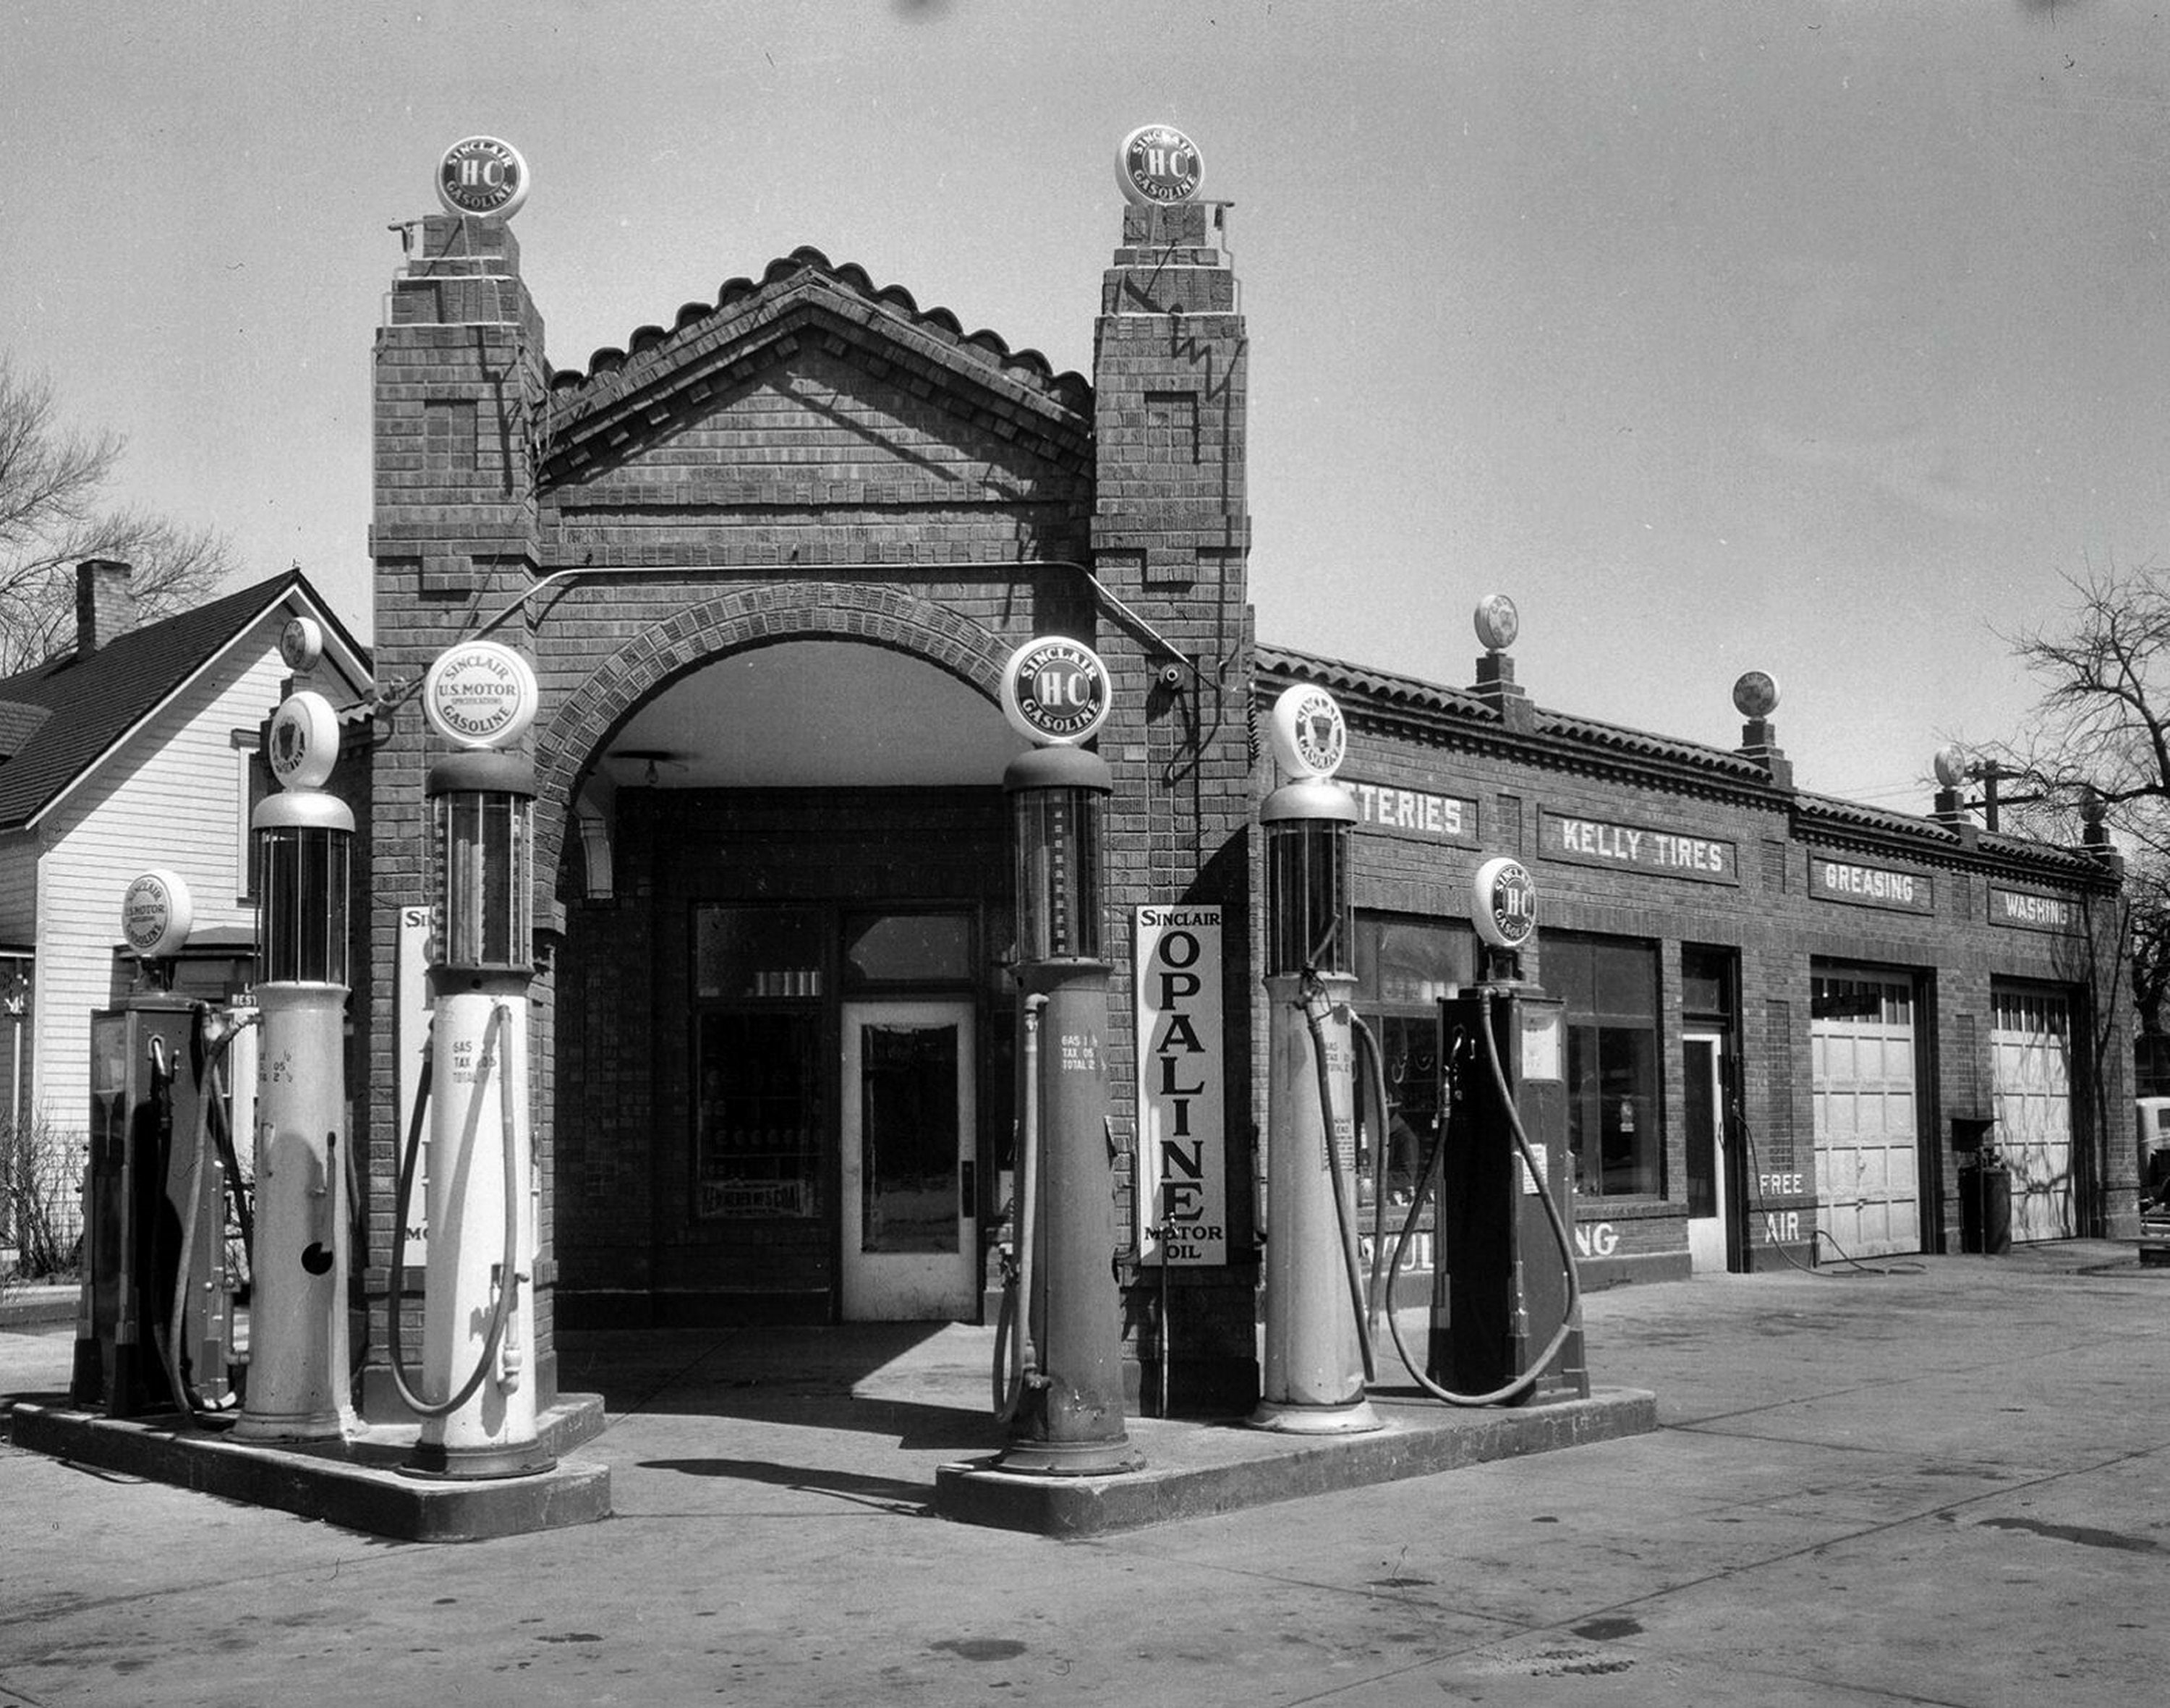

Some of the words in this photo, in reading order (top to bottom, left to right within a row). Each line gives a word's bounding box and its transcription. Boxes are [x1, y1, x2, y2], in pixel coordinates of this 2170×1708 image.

[447, 142, 513, 168] SINCLAIR
[446, 180, 514, 208] GASOLINE
[1133, 169, 1196, 200] GASOLINE
[444, 655, 509, 680] SINCLAIR
[1021, 647, 1097, 681] SINCLAIR
[443, 705, 511, 732] GASOLINE
[1022, 698, 1100, 732] GASOLINE
[1562, 819, 1641, 861] KELLY
[1654, 834, 1722, 872] TIRES
[1494, 867, 1534, 894] SINCL
[1825, 863, 1914, 903] GREASING
[1140, 909, 1221, 927] SINCLAIR
[2004, 892, 2069, 925] WASHING
[1156, 930, 1206, 1221] OPALINE
[1759, 1173, 1804, 1196] FREE
[1765, 1211, 1800, 1244] AIR
[1166, 1244, 1202, 1259] OIL
